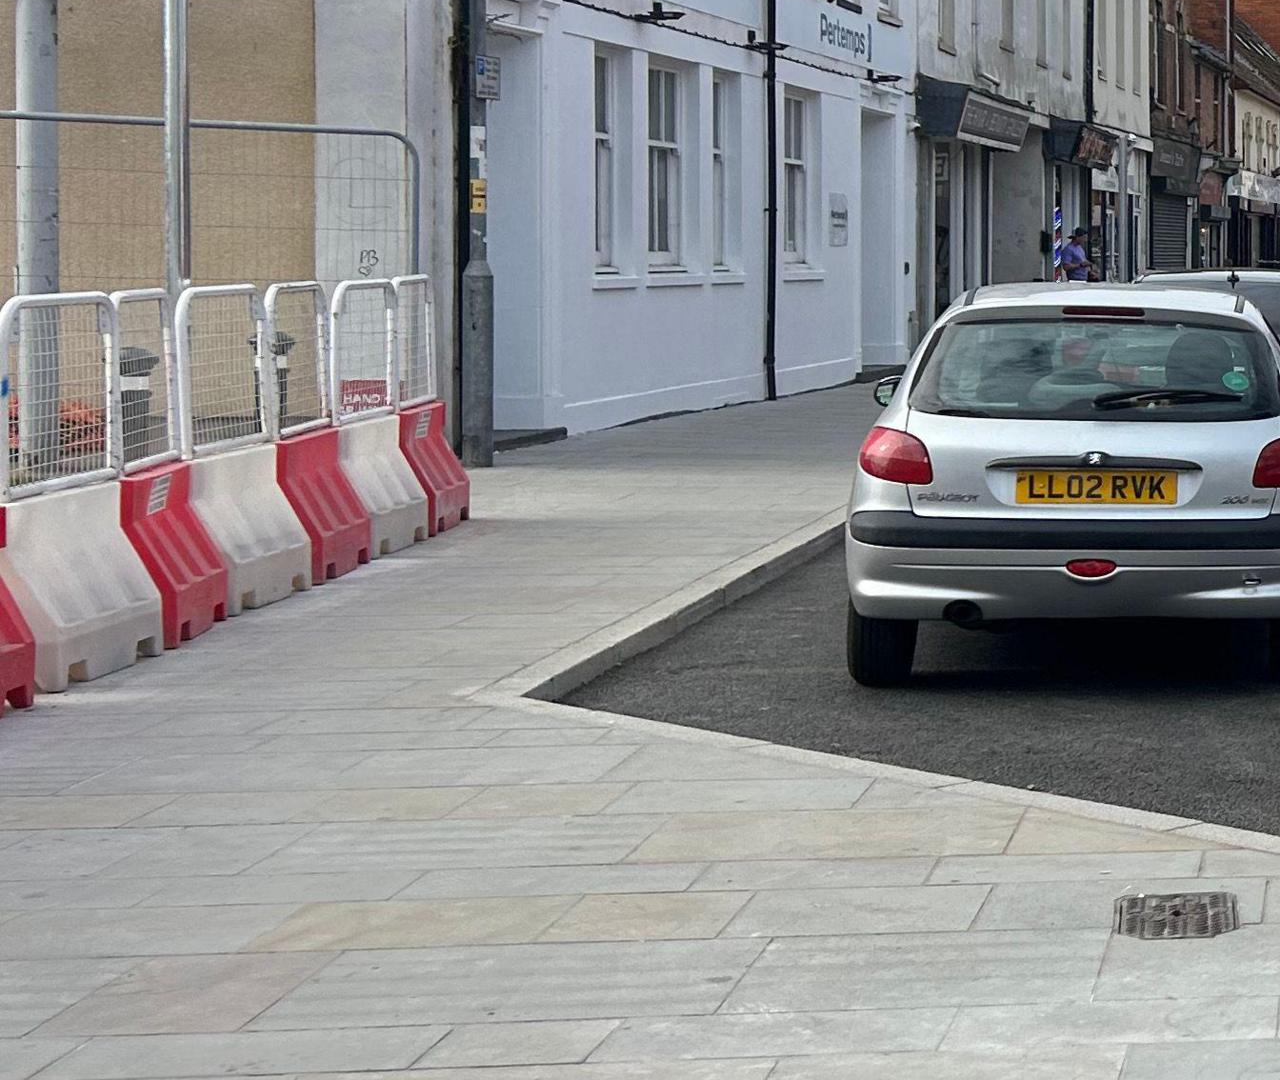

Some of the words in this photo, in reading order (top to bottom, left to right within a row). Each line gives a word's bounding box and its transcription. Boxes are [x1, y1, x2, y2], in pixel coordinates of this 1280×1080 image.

[820, 12, 866, 58] Pertemps
[343, 393, 381, 405] HAND
[1028, 475, 1103, 499] LL02
[1111, 475, 1166, 499] RVK
